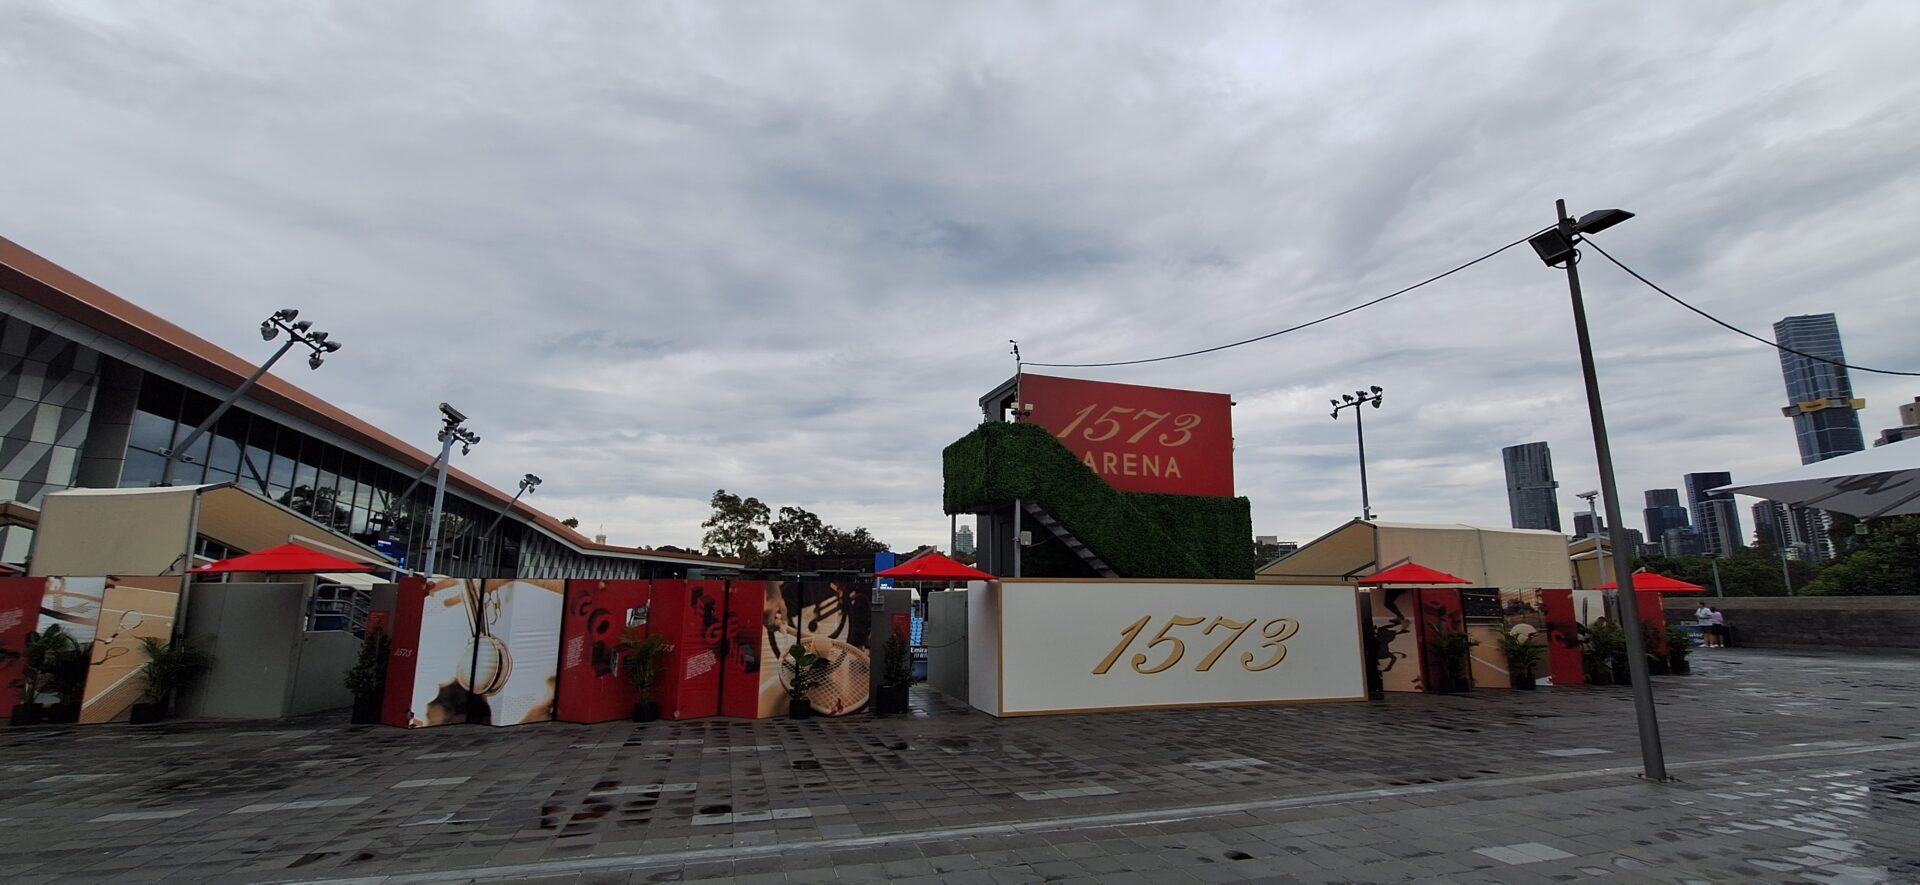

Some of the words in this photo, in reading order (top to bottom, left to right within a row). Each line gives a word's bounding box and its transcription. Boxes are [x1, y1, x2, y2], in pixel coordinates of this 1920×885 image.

[1057, 403, 1202, 448] 1573
[1083, 450, 1182, 479] ARENA
[1091, 614, 1300, 675] 1573
